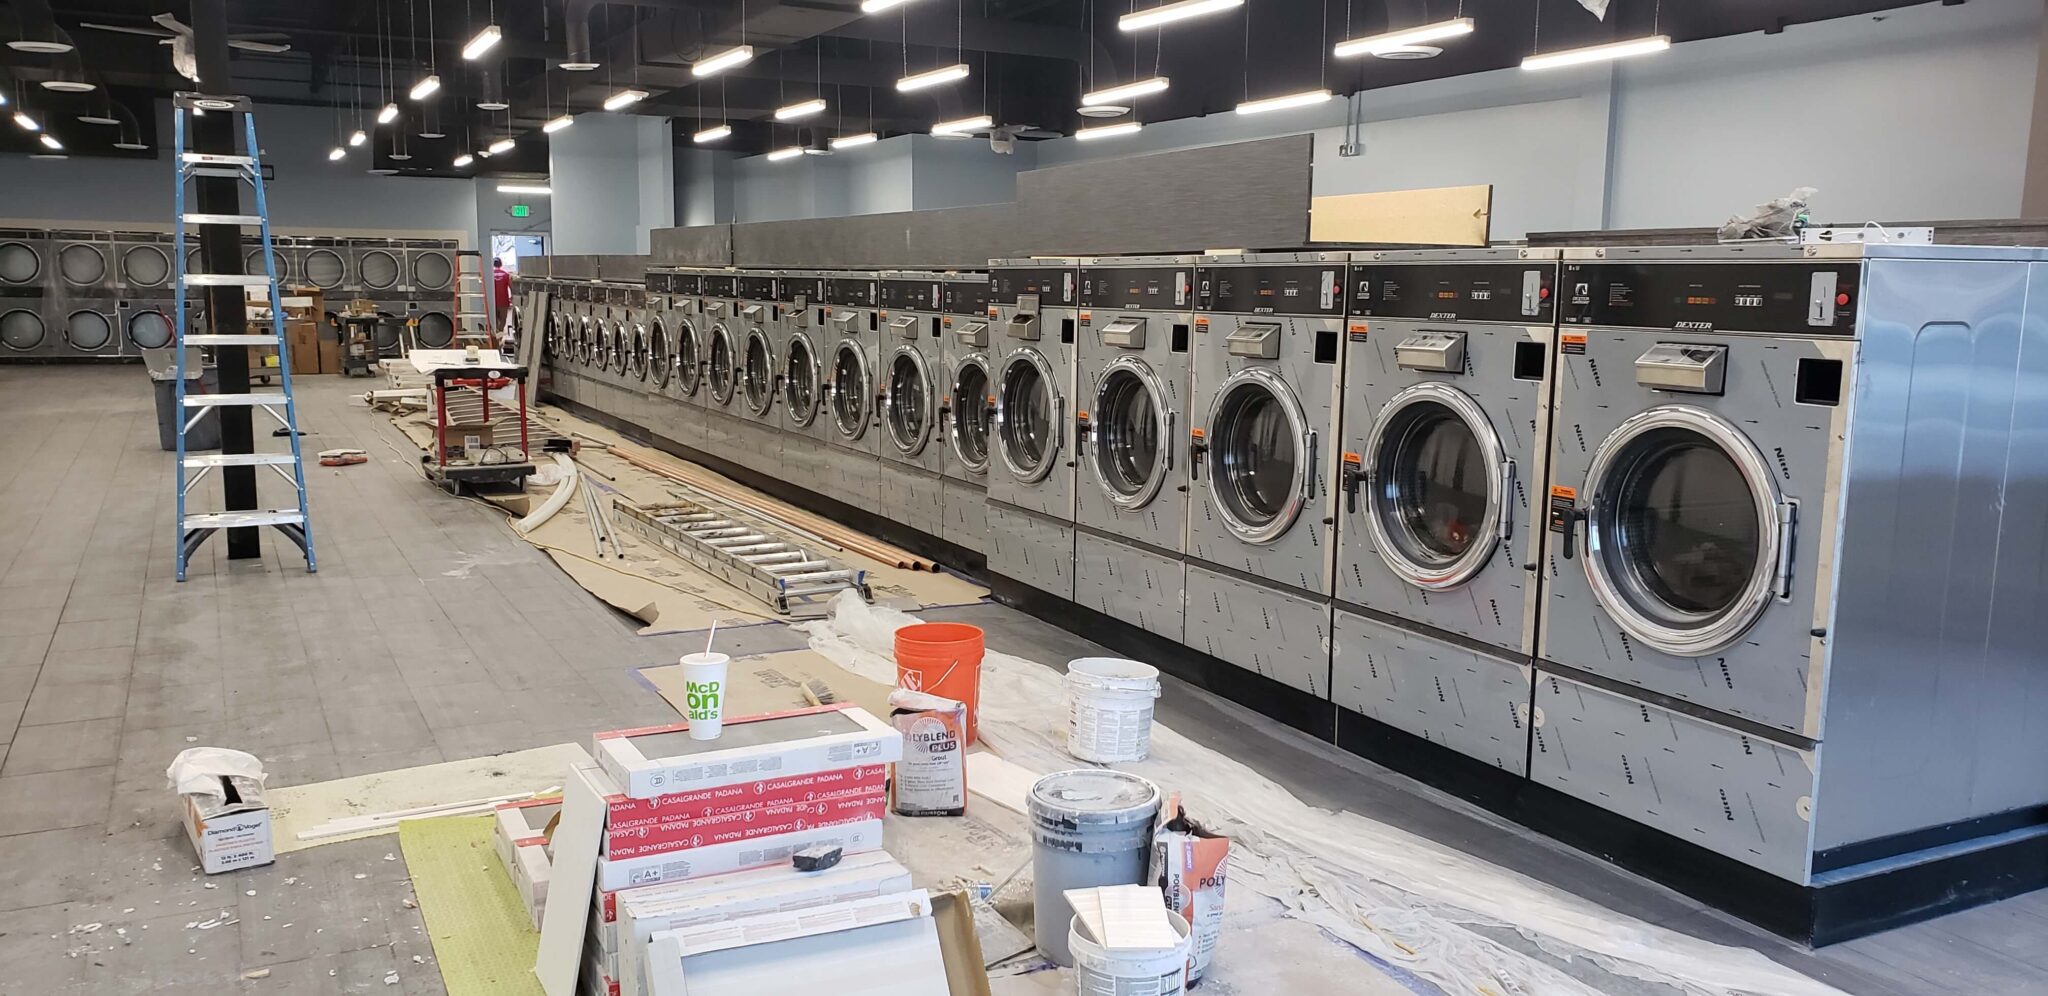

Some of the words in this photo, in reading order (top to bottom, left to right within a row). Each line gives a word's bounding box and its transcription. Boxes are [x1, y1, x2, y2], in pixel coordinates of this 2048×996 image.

[1674, 321, 1712, 329] DEXTER
[1588, 358, 1601, 387] Nitto
[1574, 424, 1586, 453] Nitto
[1773, 447, 1790, 480] Nitto
[1516, 481, 1527, 508] Nitto
[1489, 599, 1501, 626] Nitto
[1619, 631, 1633, 661] Nitto
[1717, 657, 1733, 690] Nitto
[686, 681, 720, 693] McD
[687, 693, 719, 709] on
[688, 709, 718, 721] ald's
[1509, 701, 1520, 729] Nitto
[931, 741, 956, 752] PLUS
[1621, 754, 1634, 785] Nitto
[661, 791, 712, 806] CASALGRANDE
[715, 787, 743, 798] PADANA
[767, 777, 814, 791] CASALGRANDE
[817, 773, 843, 783] PADANA
[661, 812, 690, 823] PADANA
[715, 801, 764, 815] CASALGRANDE
[766, 797, 794, 806] PADANA
[817, 786, 862, 799] CASALGRANDE
[765, 806, 793, 816] PADANA
[838, 799, 864, 809] PADANA
[1719, 788, 1734, 821] Nitto
[660, 822, 689, 832] PADANA
[692, 813, 742, 828] CASALGRANDE
[207, 827, 236, 836] Diamond
[243, 822, 262, 830] Vogel
[713, 830, 742, 841] PADANA
[745, 822, 793, 837] CASALGRANDE
[638, 838, 689, 853] CASALGRANDE
[1199, 876, 1226, 888] POLY
